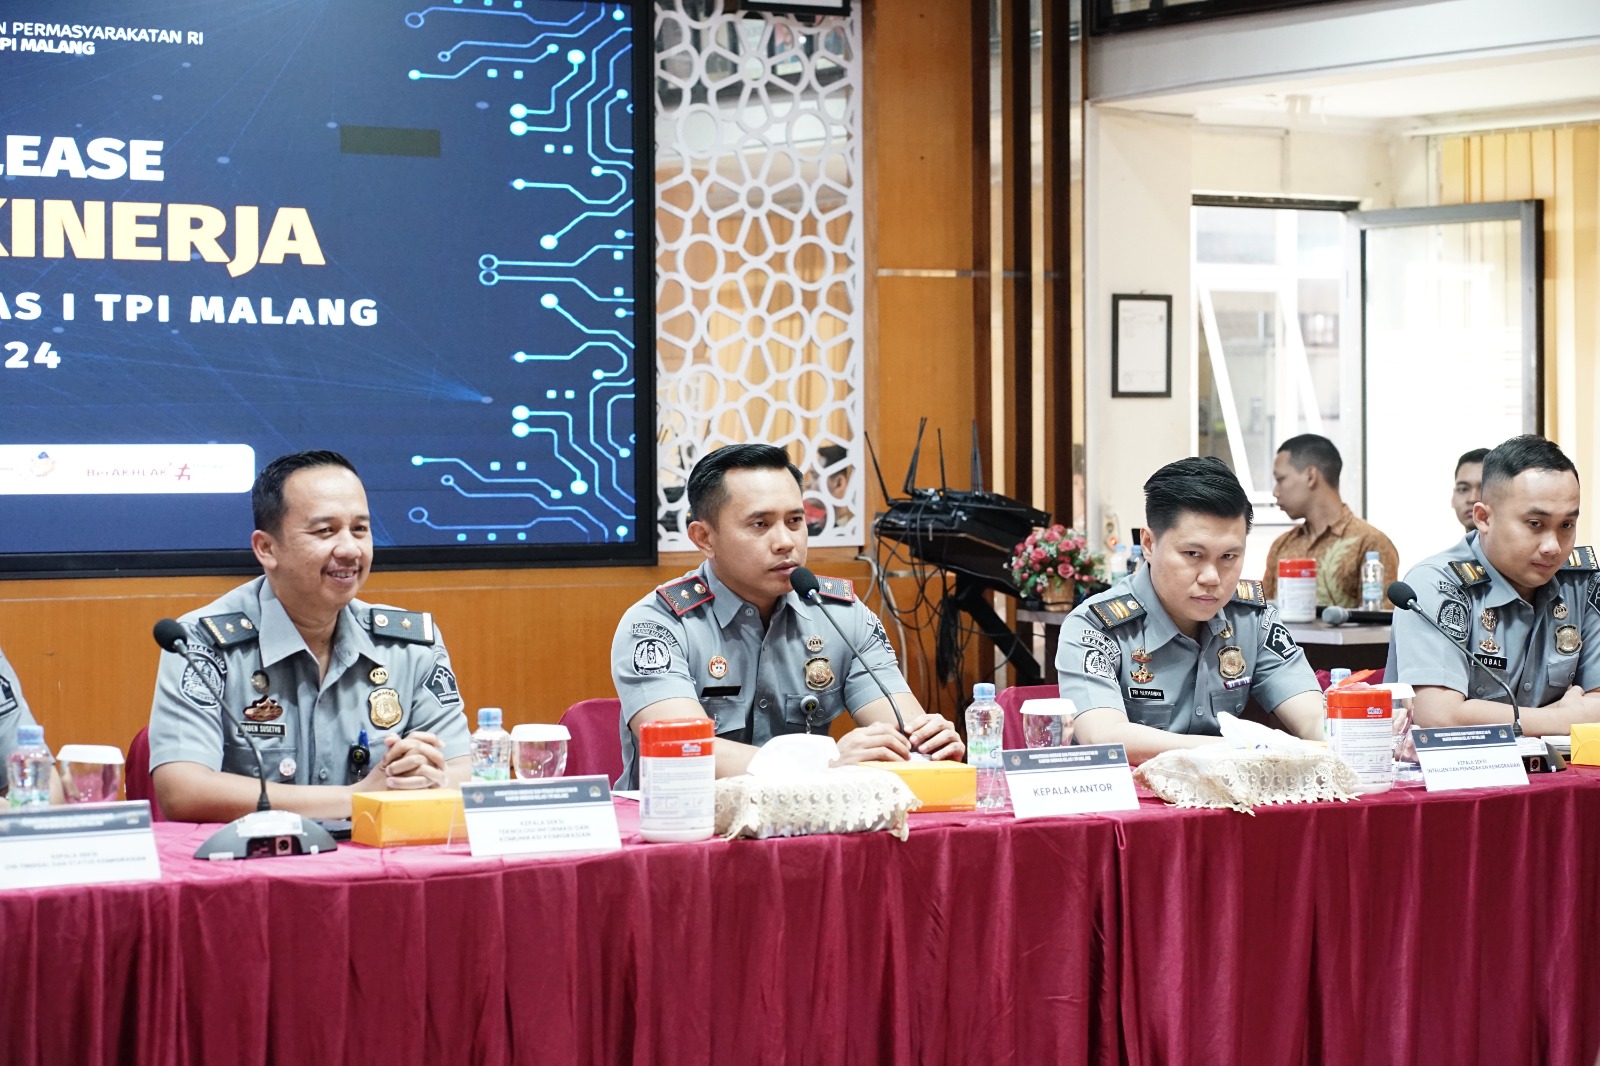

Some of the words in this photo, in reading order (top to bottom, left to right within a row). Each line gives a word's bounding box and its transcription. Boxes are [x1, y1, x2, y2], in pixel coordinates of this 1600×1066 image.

[0, 37, 17, 51] PI
[20, 38, 96, 55] MALANG
[12, 21, 182, 44] PERMASYARAKATAN
[187, 31, 204, 46] RI
[0, 134, 165, 182] EASE
[0, 197, 326, 278] INERJA
[94, 293, 170, 322] TPI
[189, 295, 378, 327] MALANG
[1033, 786, 1070, 797] KEPALA
[1072, 783, 1113, 795] KANTOR
